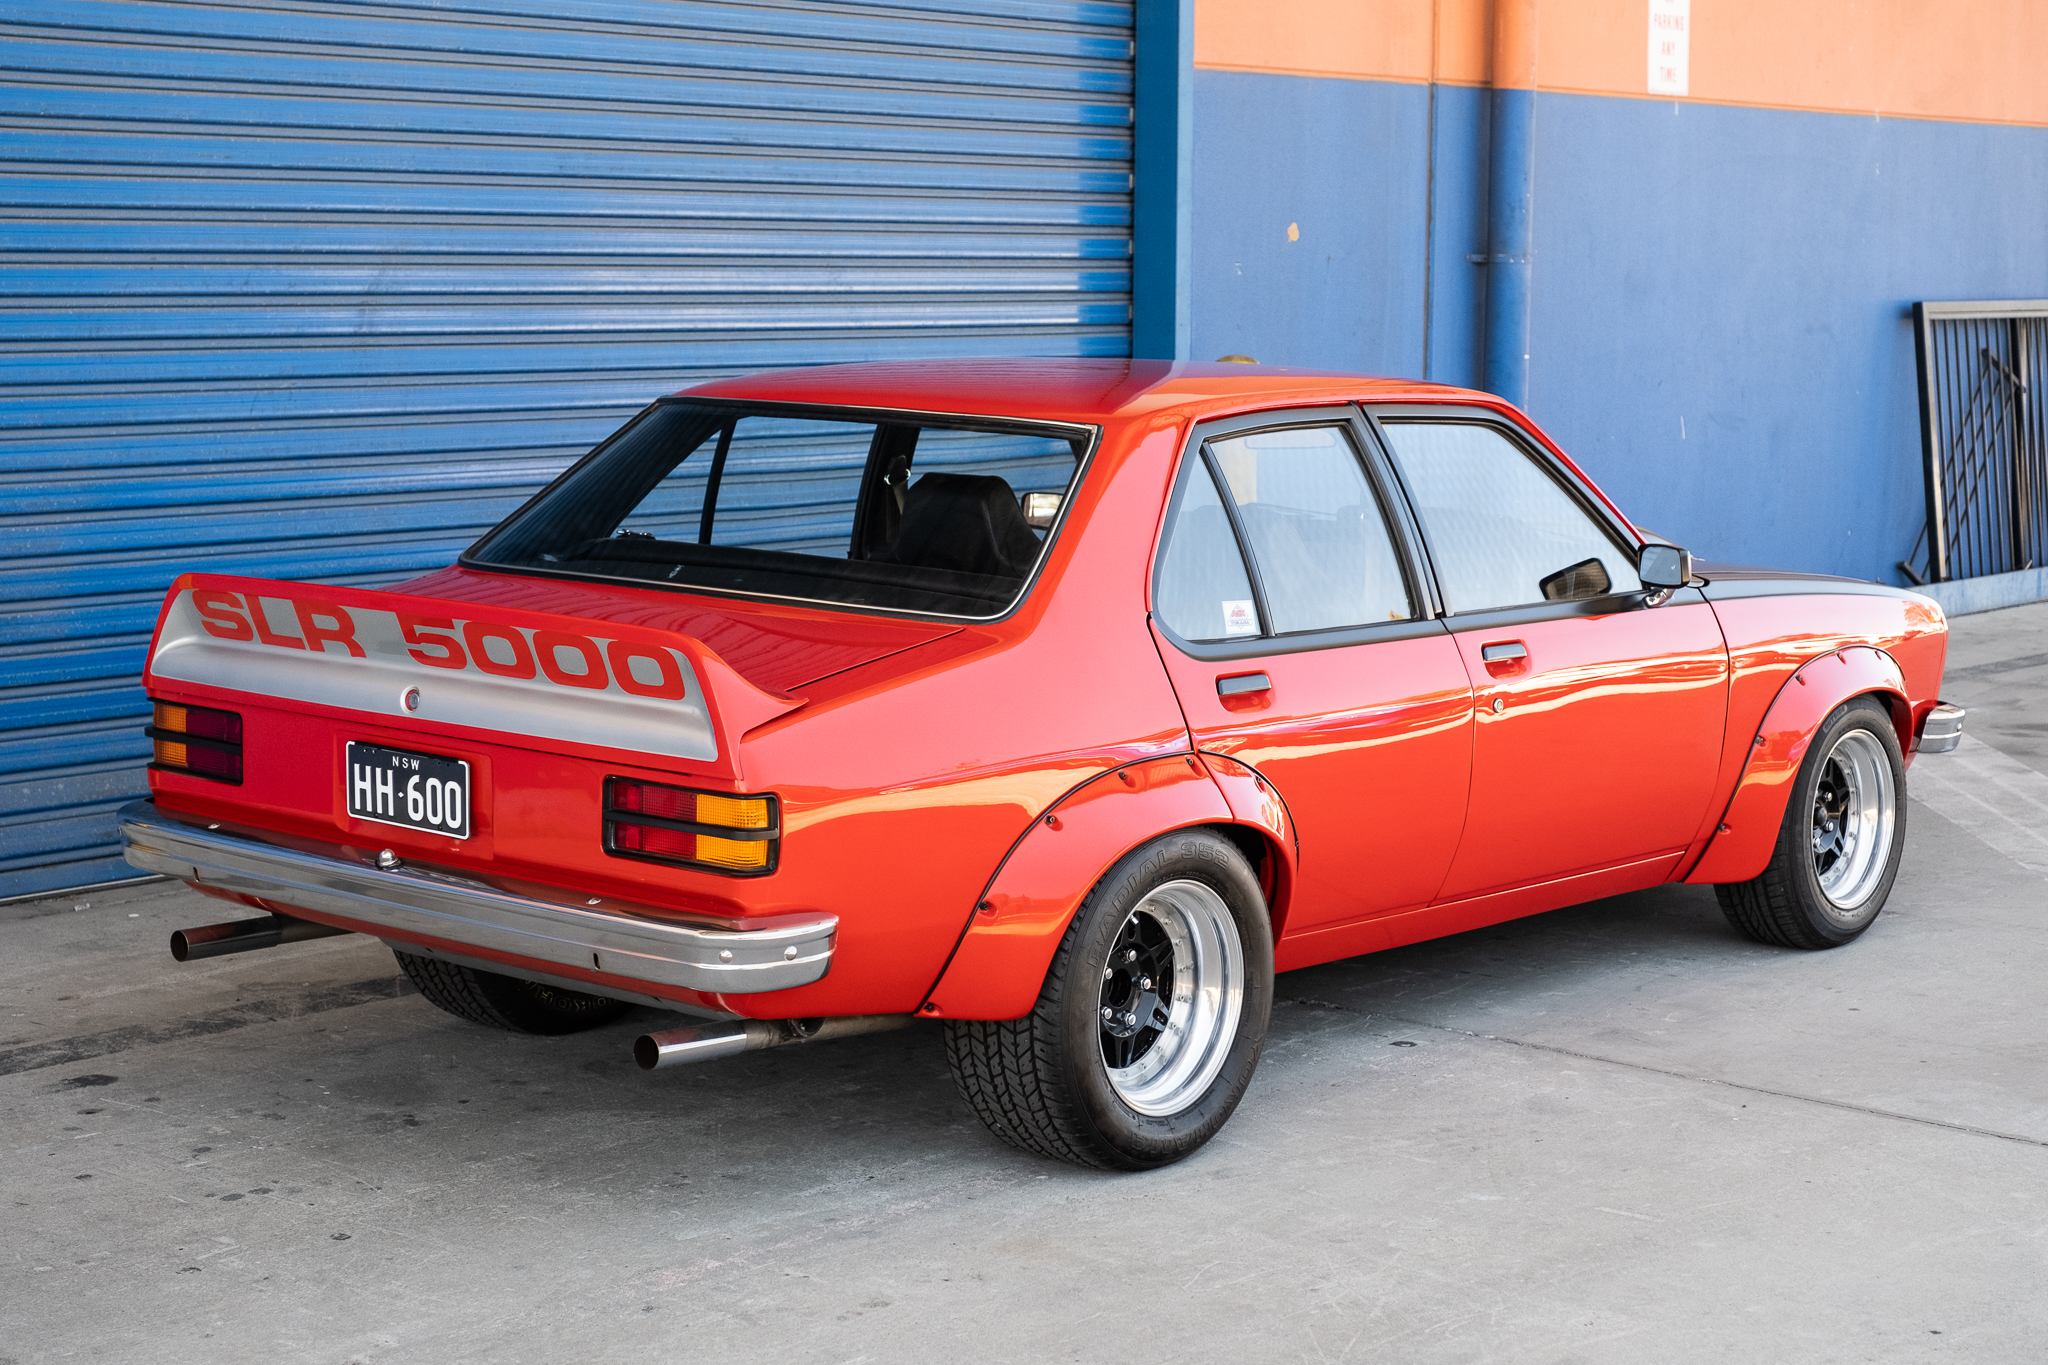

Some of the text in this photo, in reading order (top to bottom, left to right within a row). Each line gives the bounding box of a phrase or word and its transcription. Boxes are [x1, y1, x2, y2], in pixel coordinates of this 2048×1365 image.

[1654, 13, 1685, 31] PARKING
[1661, 41, 1676, 56] ANY
[1660, 66, 1677, 83] TIME
[191, 588, 686, 701] SLR 5000
[392, 755, 420, 771] NSW
[1086, 841, 1230, 968] RADIAL 352
